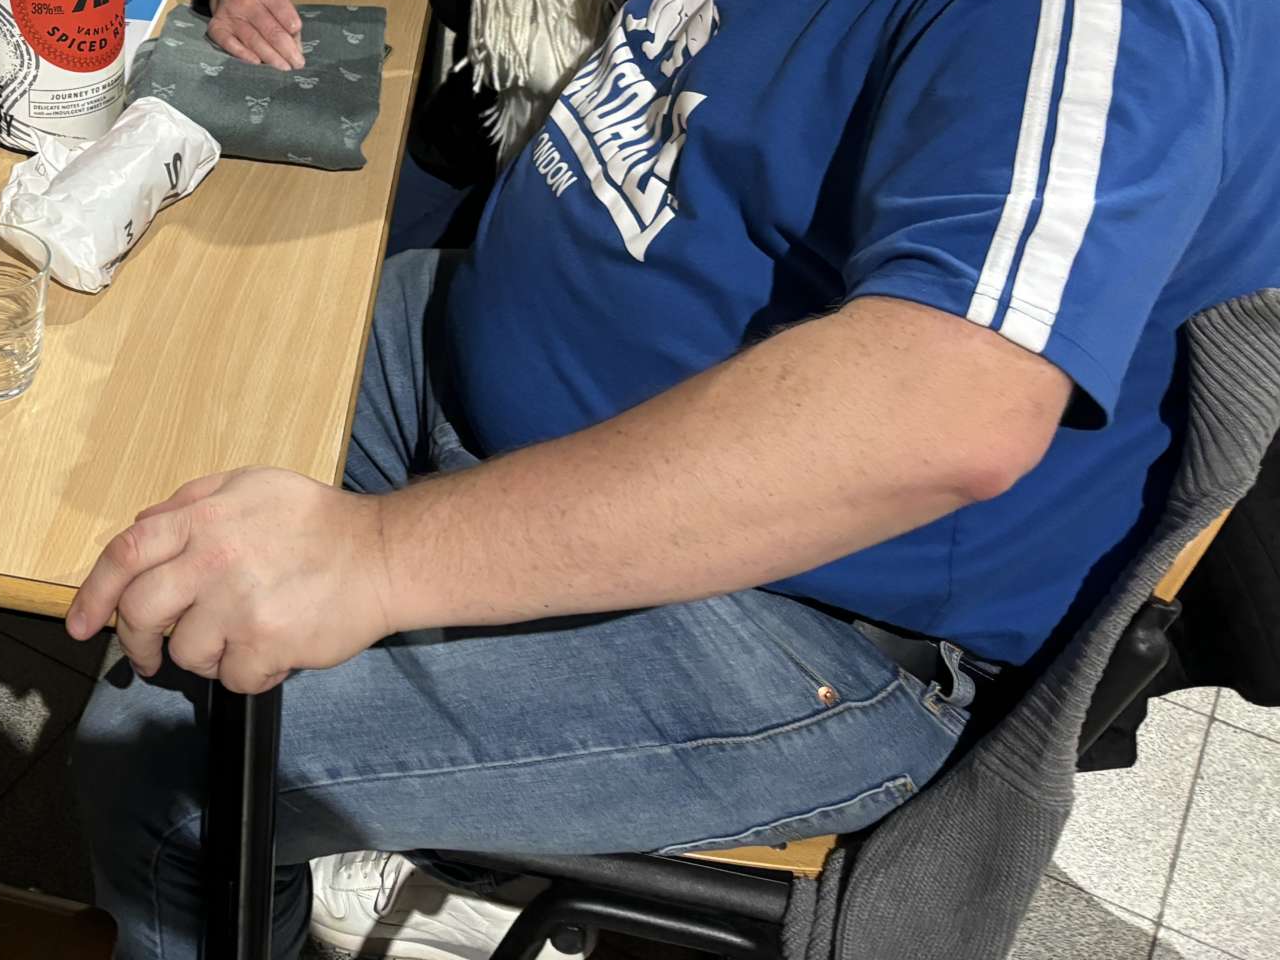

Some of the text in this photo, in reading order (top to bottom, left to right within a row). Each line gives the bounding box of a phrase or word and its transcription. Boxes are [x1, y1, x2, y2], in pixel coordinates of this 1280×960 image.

[31, 2, 53, 15] 38%
[47, 26, 108, 52] SPICED
[51, 90, 89, 101] JOURNEY
[533, 132, 578, 198] ONDON
